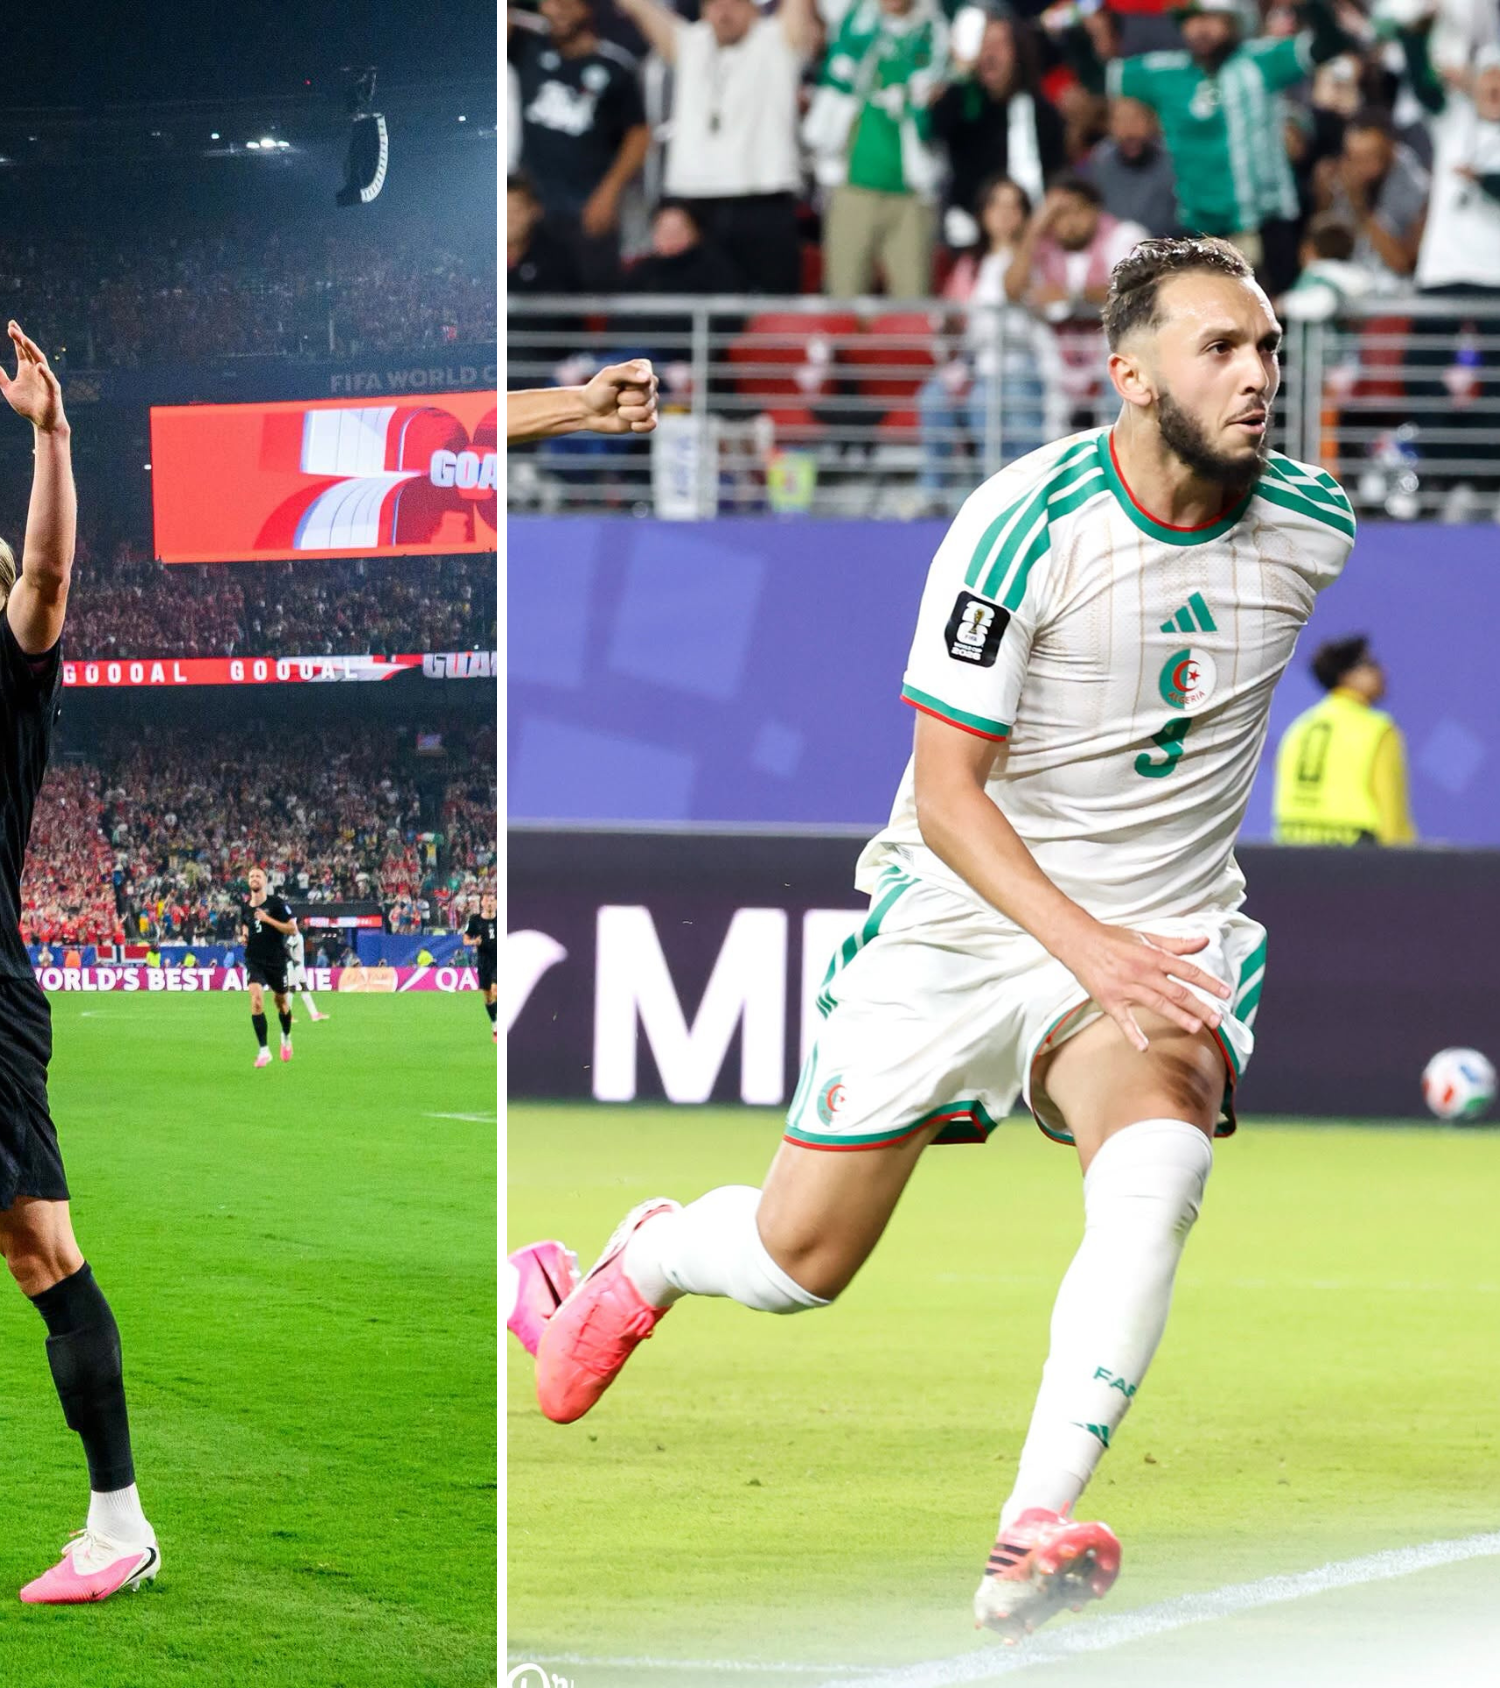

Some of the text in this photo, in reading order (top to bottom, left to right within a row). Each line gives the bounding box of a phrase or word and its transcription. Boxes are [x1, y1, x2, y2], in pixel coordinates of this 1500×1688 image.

[330, 372, 383, 393] FIFA
[386, 366, 478, 390] WORLD
[63, 660, 357, 684] GOOOAL GOOOAL
[1168, 691, 1205, 705] ALGERIA
[146, 967, 215, 991] BEST
[435, 967, 479, 992] QA
